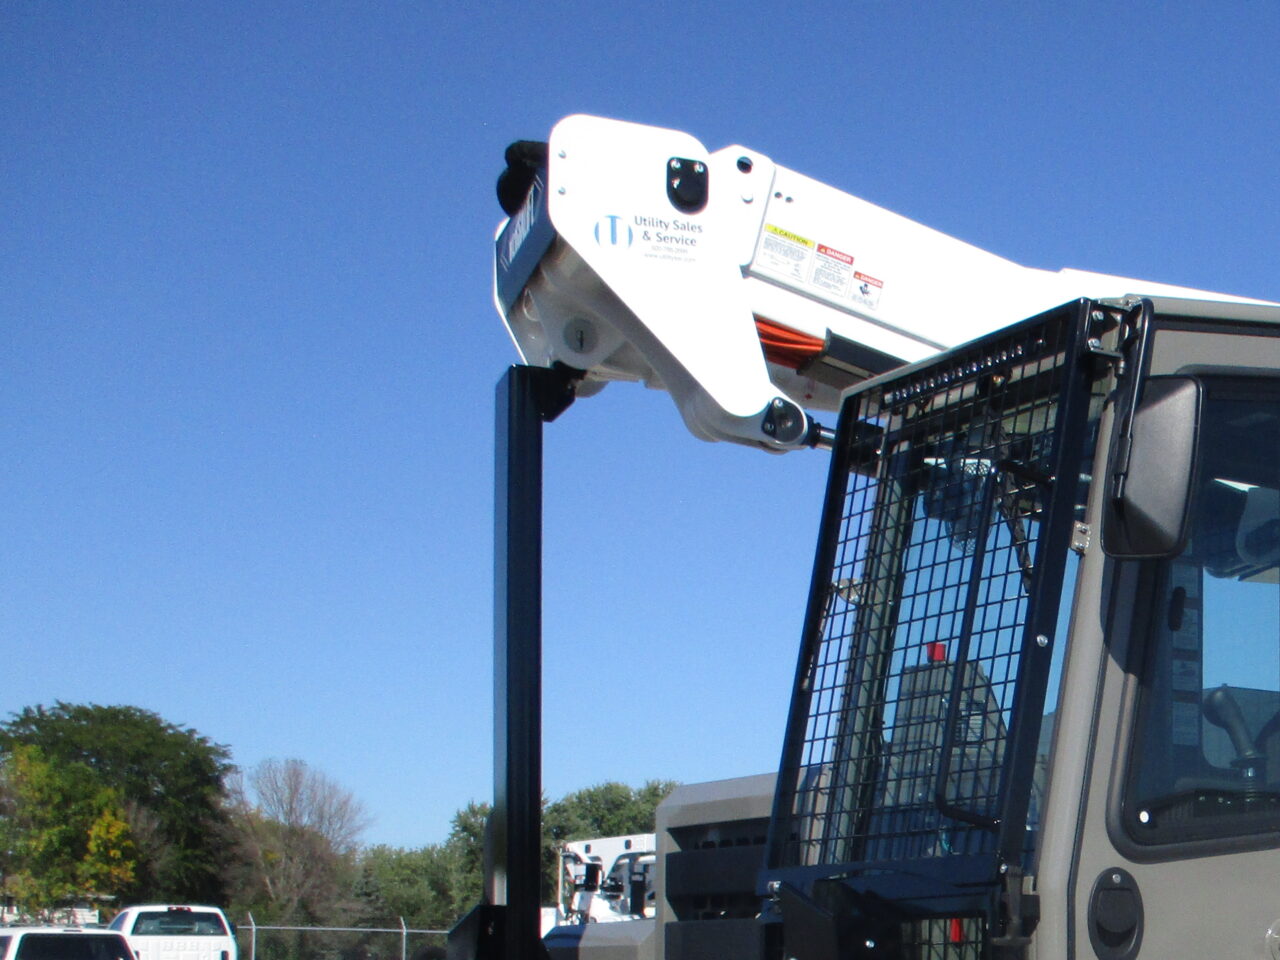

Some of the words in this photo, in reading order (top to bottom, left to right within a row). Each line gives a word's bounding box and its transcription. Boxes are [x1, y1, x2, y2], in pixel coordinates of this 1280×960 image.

[634, 215, 670, 231] Utility
[673, 219, 703, 233] Sales
[642, 230, 651, 241] &
[656, 232, 697, 247] Service
[778, 229, 809, 246] CAUTION
[826, 248, 852, 263] DANGER
